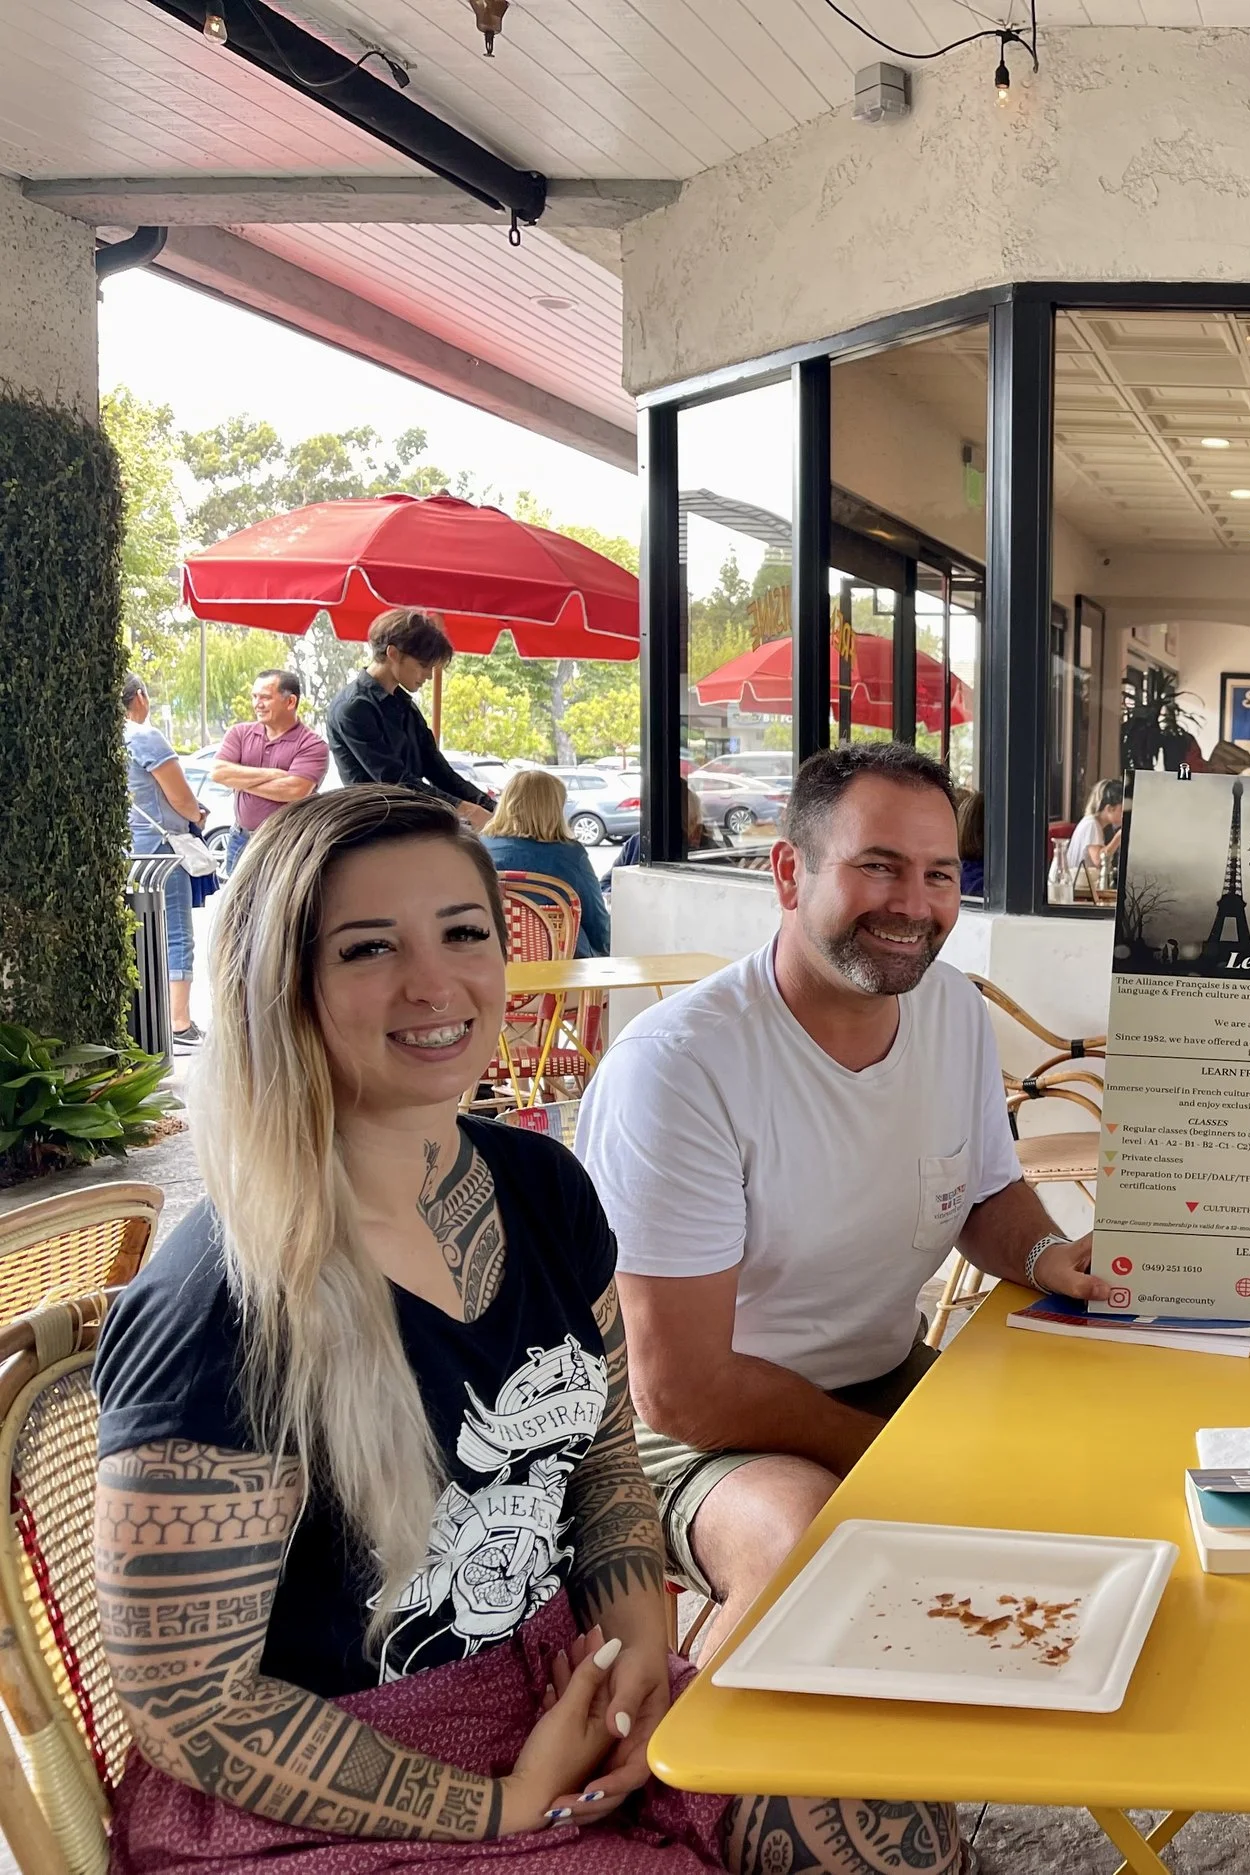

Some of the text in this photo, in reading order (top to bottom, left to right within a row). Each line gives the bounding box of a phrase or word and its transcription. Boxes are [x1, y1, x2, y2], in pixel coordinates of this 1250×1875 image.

[1115, 976, 1134, 985] The
[1135, 977, 1175, 987] Alliance
[1174, 980, 1221, 991] Française
[1221, 982, 1230, 990] is
[1117, 985, 1160, 996] language
[1170, 988, 1203, 998] French
[1204, 990, 1239, 999] culture
[1214, 1018, 1229, 1027] We
[1114, 1032, 1141, 1041] Since
[1183, 1035, 1206, 1044] have
[1207, 1037, 1241, 1046] offered
[1201, 1066, 1237, 1076] LEARN
[1106, 1083, 1144, 1092] Immerse
[1145, 1086, 1180, 1094] yourself
[1191, 1087, 1222, 1096] French
[1187, 1118, 1228, 1127] CLASSES
[1122, 1124, 1156, 1133] Regular
[1157, 1126, 1188, 1135] classes
[1188, 1127, 1236, 1137] (beginners
[1121, 1136, 1142, 1145] level
[1148, 1138, 1158, 1146] A1
[1184, 1140, 1195, 1148] B1
[1202, 1140, 1213, 1148] B2
[1121, 1153, 1184, 1164] Private classes
[1120, 1168, 1172, 1178] Preparation
[1118, 1182, 1176, 1191] certifications
[1141, 1262, 1203, 1273] (949) 251 1610
[1137, 1294, 1215, 1306] @aforangecounty
